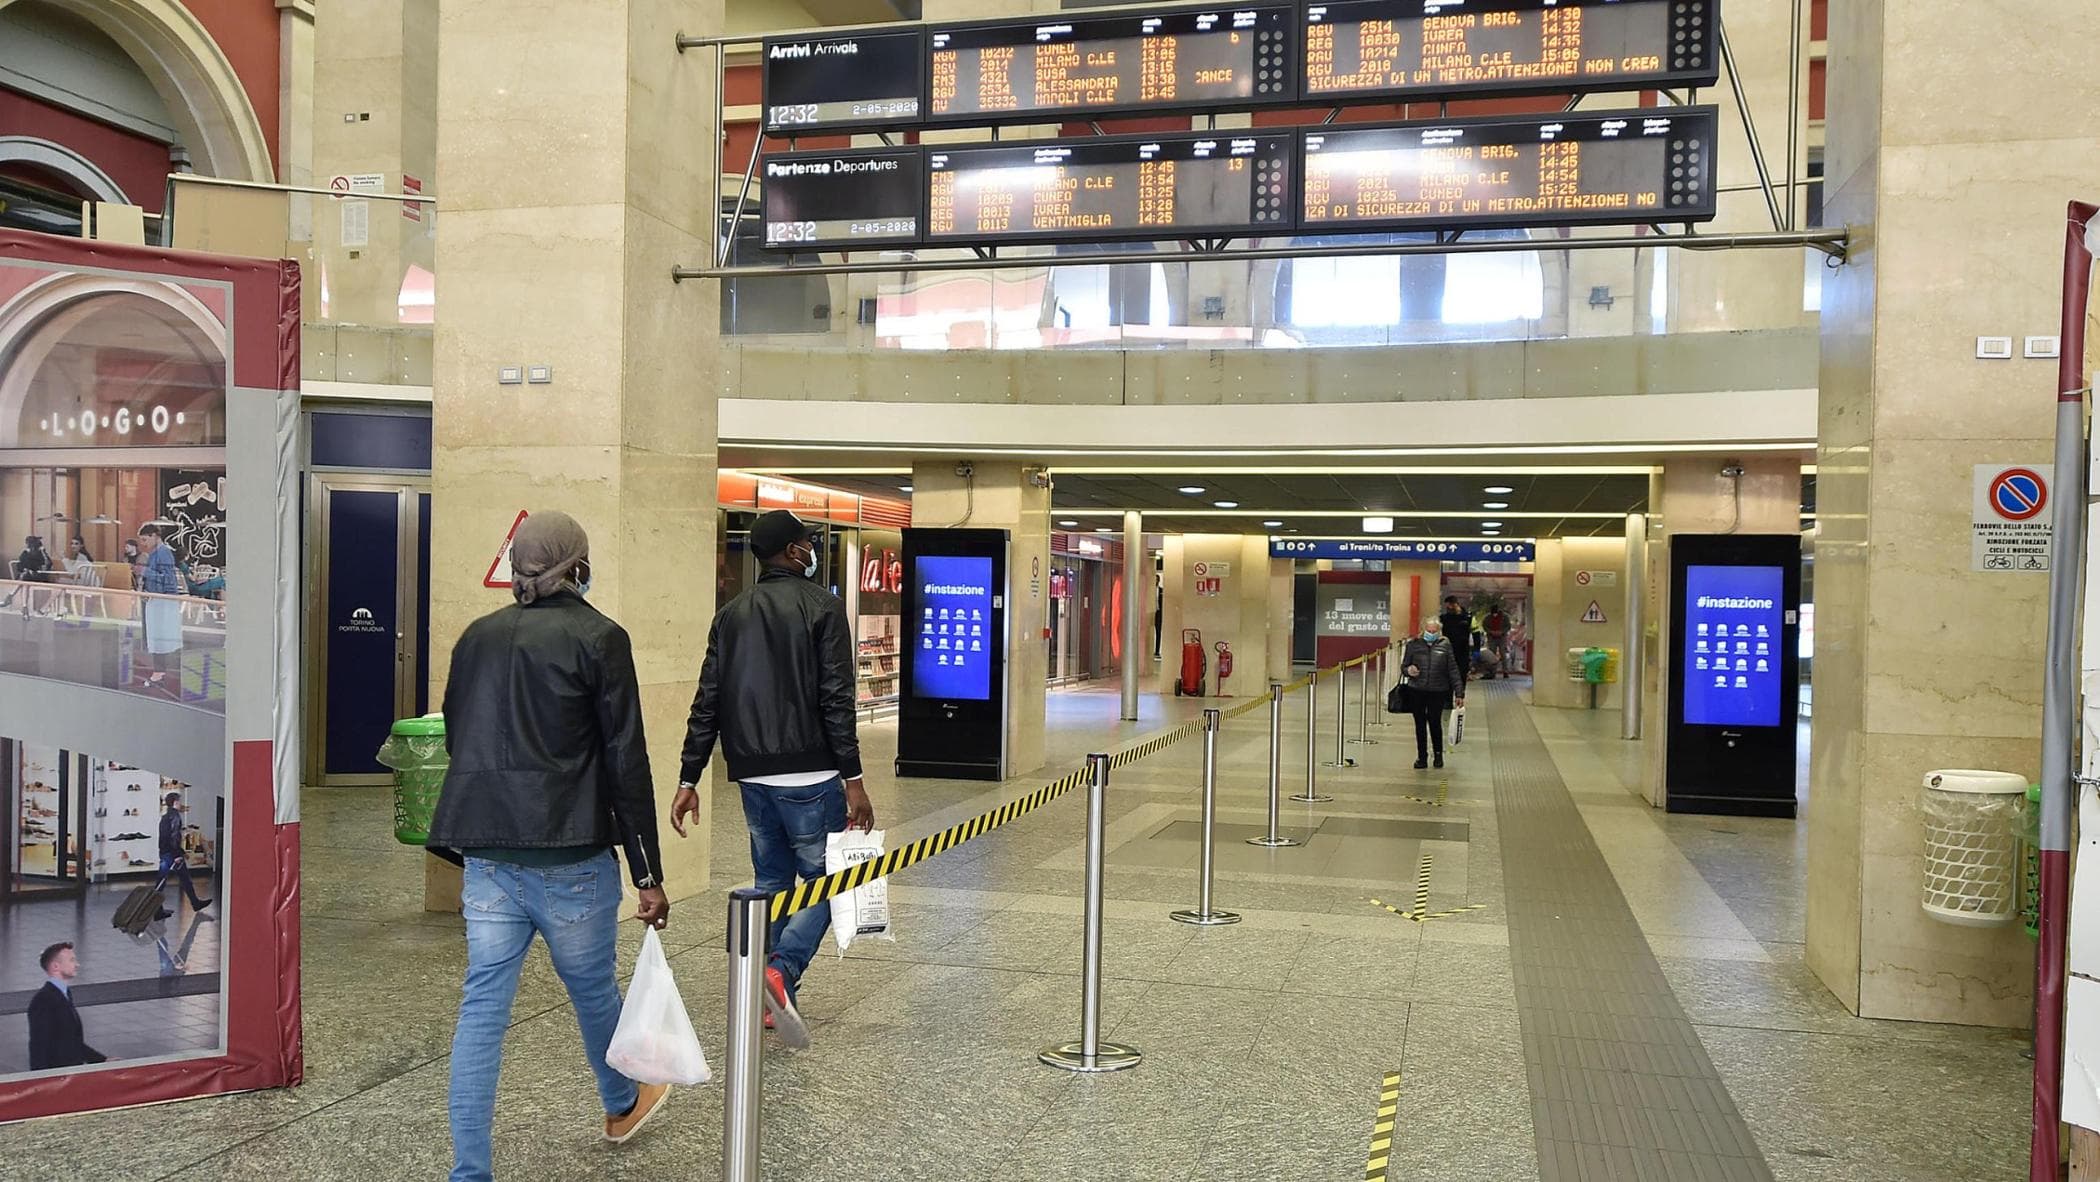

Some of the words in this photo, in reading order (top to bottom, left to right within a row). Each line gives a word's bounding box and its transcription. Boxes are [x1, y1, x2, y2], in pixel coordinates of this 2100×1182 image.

[1307, 24, 1334, 37] RGV
[1360, 20, 1393, 34] 2514
[1423, 14, 1475, 29] GENOVA
[1483, 12, 1522, 26] BRIG.
[1542, 8, 1581, 22] 14:30
[1307, 37, 1333, 50] REG
[1423, 29, 1464, 42] IVREA
[1542, 21, 1581, 35] 14:32
[770, 43, 811, 59] Arrivi
[814, 40, 858, 55] Arrivals
[933, 52, 956, 62] RGV
[980, 47, 1014, 59] 10212
[1036, 44, 1075, 55] CUNEO
[933, 63, 955, 74] RGV
[979, 60, 1008, 72] 2014
[1036, 55, 1080, 68] MILANO
[1087, 52, 1116, 65] C.LE
[1141, 49, 1176, 62] 13:06
[1307, 63, 1332, 77] RGV
[1422, 54, 1472, 69] MILANO
[1480, 52, 1512, 66] C.LE
[1541, 47, 1580, 62] 15:06
[932, 75, 955, 87] FM3
[979, 71, 1008, 84] 4321
[1036, 68, 1067, 81] SUSA
[1141, 61, 1174, 74] 13:15
[1309, 73, 1383, 89] SICUREZZA
[1391, 72, 1405, 84] DI
[1413, 70, 1431, 83] UN
[1586, 59, 1614, 72] NON
[1621, 56, 1660, 71] CREA
[932, 87, 956, 99] RGV
[979, 84, 1010, 96] 2534
[1035, 76, 1118, 93] ALESSANDRIA
[1141, 74, 1176, 86] 13:30
[979, 96, 1017, 108] 35332
[1086, 89, 1115, 103] C.LE
[1141, 86, 1176, 99] 13:45
[769, 104, 818, 125] 12:32
[853, 101, 918, 115] 2-05-2020
[1481, 144, 1519, 158] BRIG.
[1540, 142, 1579, 155] 14:30
[768, 163, 831, 176] Partenze
[834, 159, 898, 174] Departures
[931, 172, 954, 183] FM3
[1139, 161, 1175, 174] 12:45
[1228, 159, 1243, 170] 13
[1539, 156, 1578, 168] 14:45
[931, 184, 954, 195] RGV
[1085, 177, 1113, 189] C.LE
[1139, 175, 1174, 187] 12:54
[1305, 180, 1330, 191] RGV
[1358, 178, 1389, 189] 2021
[1420, 174, 1470, 186] MILANO
[1478, 171, 1509, 184] C.LE
[1539, 169, 1578, 182] 14:54
[931, 197, 953, 208] RGV
[1034, 191, 1072, 202] CUNEO
[1139, 187, 1174, 199] 13:25
[1420, 187, 1463, 199] CUNEO
[1539, 183, 1577, 195] 15:25
[931, 209, 953, 220] REG
[1033, 204, 1069, 215] IVREA
[1139, 200, 1173, 211] 13:28
[1334, 205, 1348, 216] DI
[1357, 202, 1430, 216] SICUREZZA
[1439, 201, 1453, 212] DI
[1463, 200, 1480, 212] UN
[1637, 193, 1655, 205] NO
[766, 221, 816, 242] 12:32
[851, 221, 916, 234] 2-05-2020
[930, 221, 953, 232] RGV
[977, 219, 1008, 231] 10113
[1033, 214, 1112, 228] VENTIMIGLIA
[1138, 212, 1173, 224] 14:25
[1340, 543, 1348, 551] ai
[1385, 543, 1411, 551] Trains
[924, 584, 985, 595] #instazione
[1697, 596, 1773, 609] #instazione
[1325, 611, 1338, 620] 13
[1342, 612, 1374, 620] nuove
[1329, 621, 1344, 631] del
[1348, 622, 1378, 632] gusto
